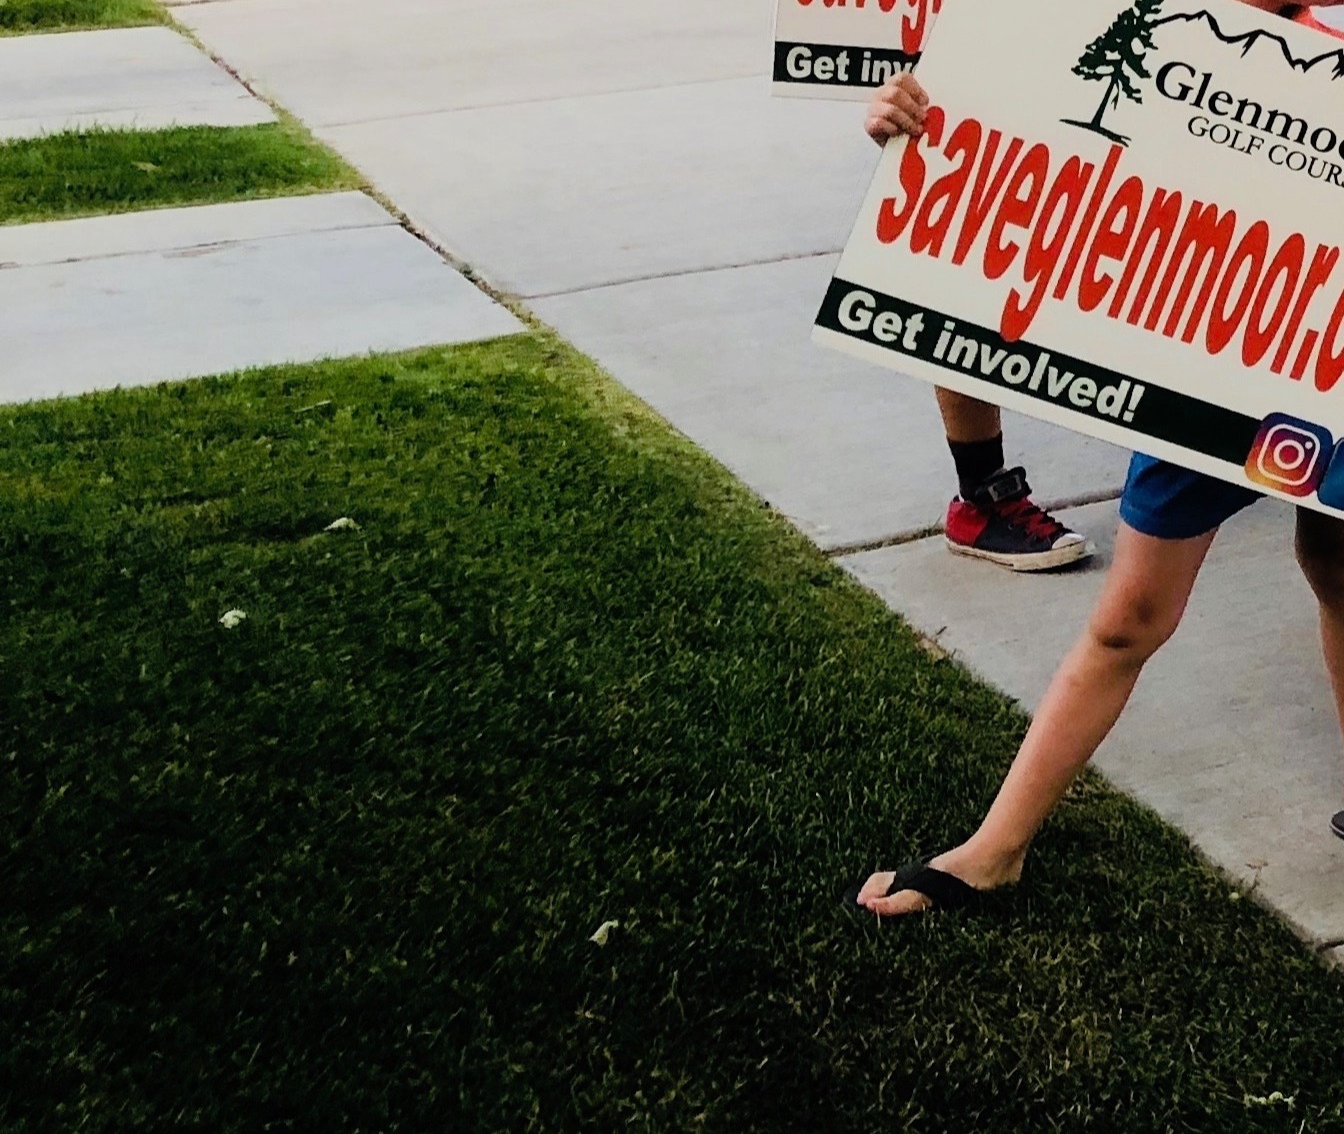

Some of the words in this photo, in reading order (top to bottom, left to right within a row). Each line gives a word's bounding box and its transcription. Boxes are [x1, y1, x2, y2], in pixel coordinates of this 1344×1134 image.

[786, 46, 850, 81] Get
[1188, 116, 1265, 157] GOLF
[838, 290, 924, 350] Get
[932, 316, 1146, 424] involved!
